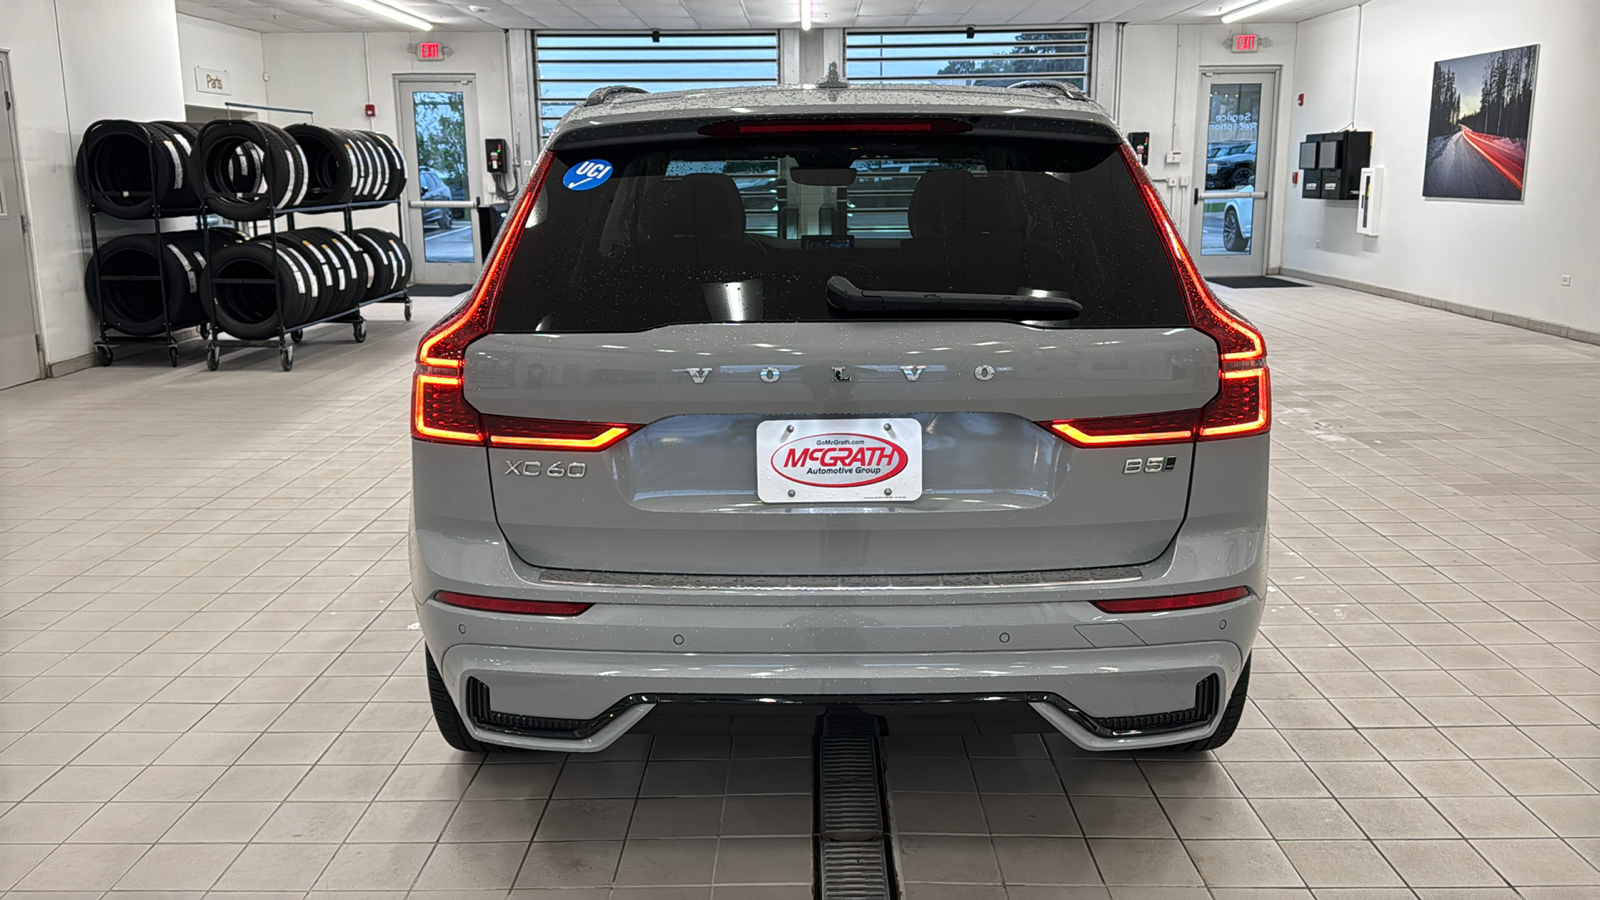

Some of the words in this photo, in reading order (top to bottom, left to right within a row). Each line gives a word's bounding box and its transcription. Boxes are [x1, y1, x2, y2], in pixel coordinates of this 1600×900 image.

[421, 42, 439, 58] EXIT
[1236, 34, 1256, 50] EXIT
[206, 73, 223, 90] Parts
[576, 161, 611, 179] UCI
[806, 466, 853, 475] Automotive
[855, 466, 881, 475] Group
[1124, 457, 1164, 474] B5
